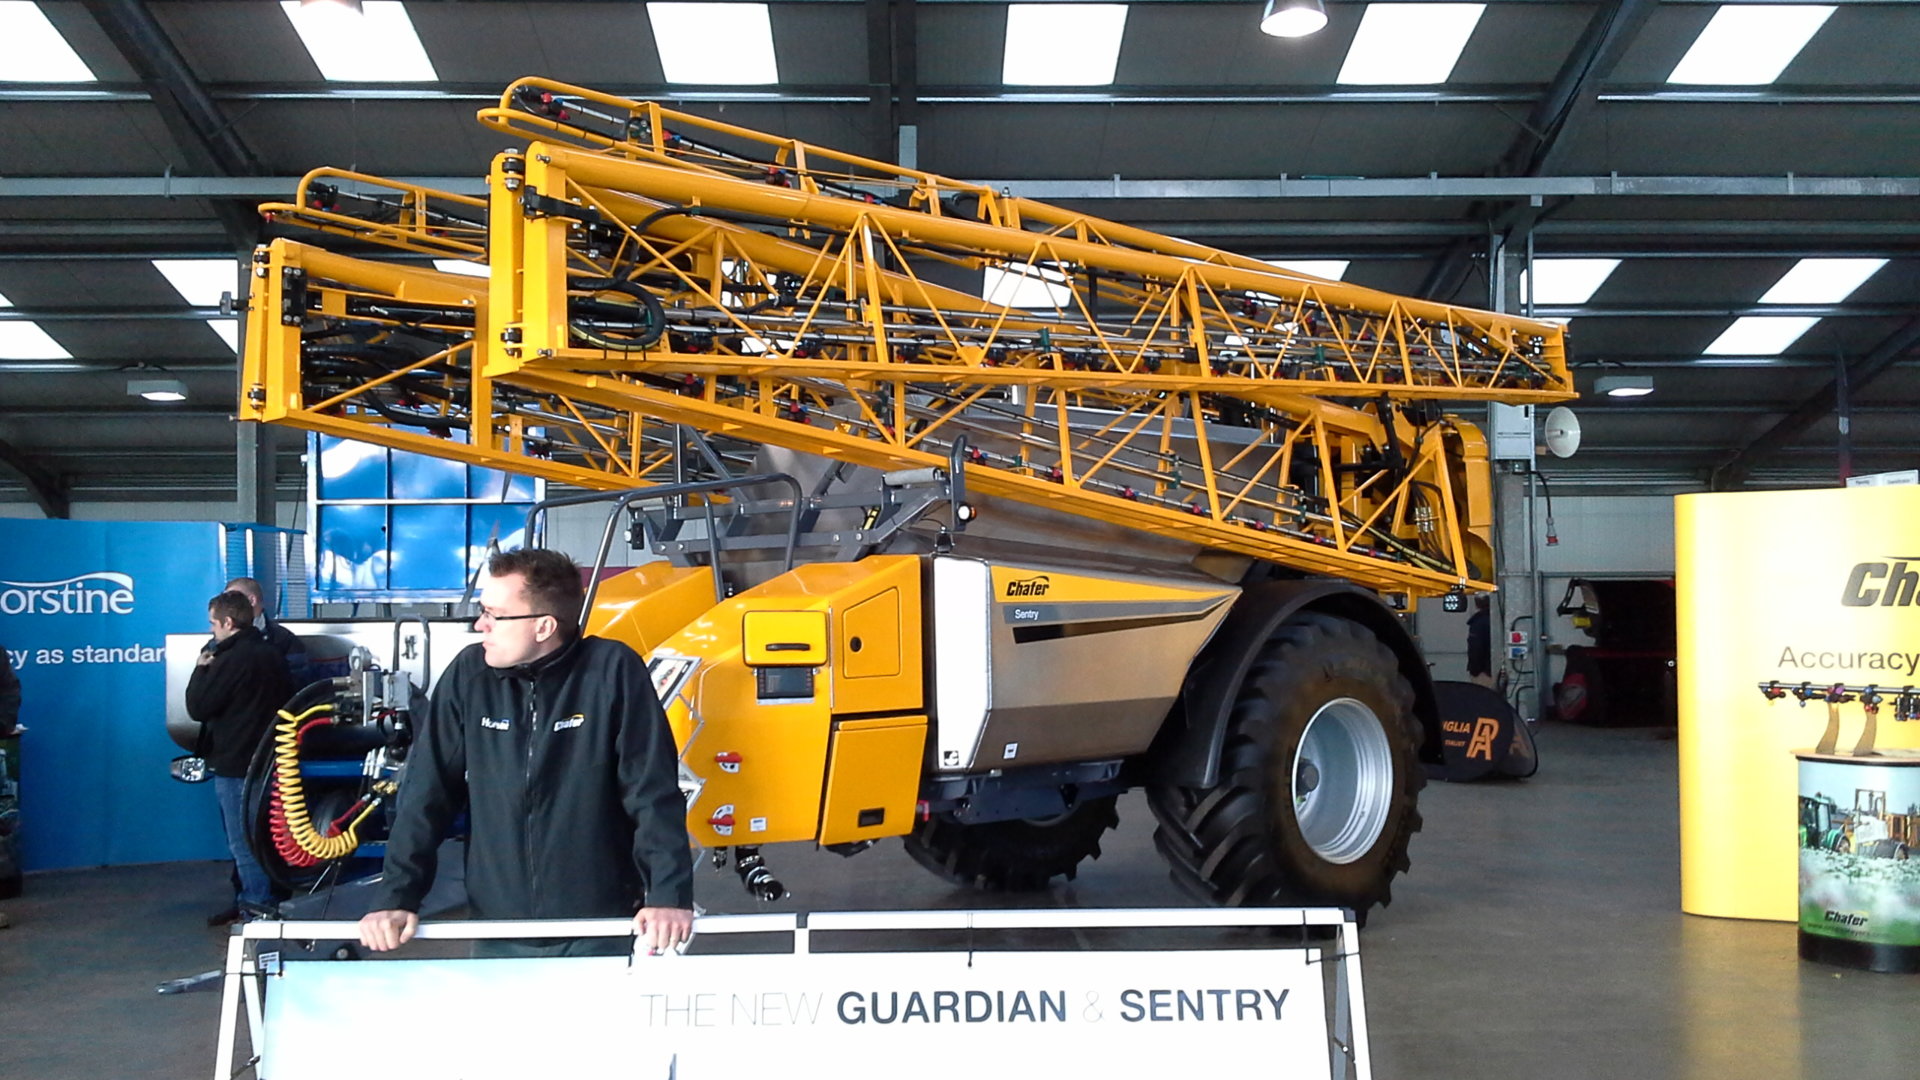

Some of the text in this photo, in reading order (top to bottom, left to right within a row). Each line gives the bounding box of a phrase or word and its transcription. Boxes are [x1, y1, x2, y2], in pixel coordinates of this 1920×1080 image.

[1006, 581, 1050, 596] Chafer
[1841, 561, 1920, 607] Ch
[1015, 609, 1039, 621] Sentry
[36, 649, 64, 664] as
[72, 643, 168, 664] standar
[1778, 646, 1920, 676] Accuracy
[1825, 910, 1868, 926] Chafer
[640, 988, 1290, 1027] THE NEW GUARDIAN & SENTRY
